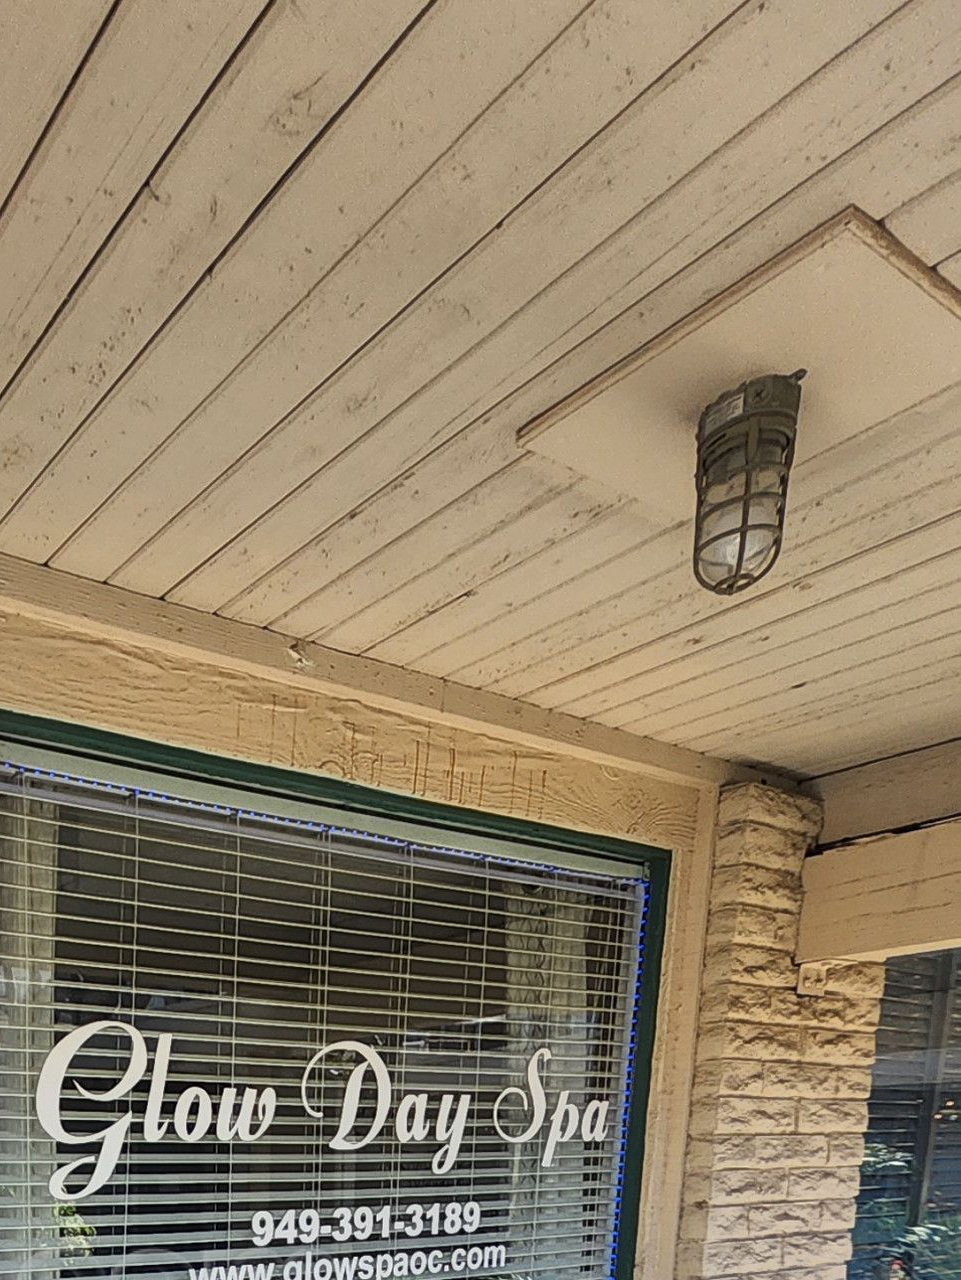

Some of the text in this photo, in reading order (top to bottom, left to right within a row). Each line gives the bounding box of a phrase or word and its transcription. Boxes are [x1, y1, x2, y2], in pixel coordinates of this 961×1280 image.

[35, 1020, 609, 1200] Glow Day Spa
[251, 1201, 481, 1247] 949-391-3189
